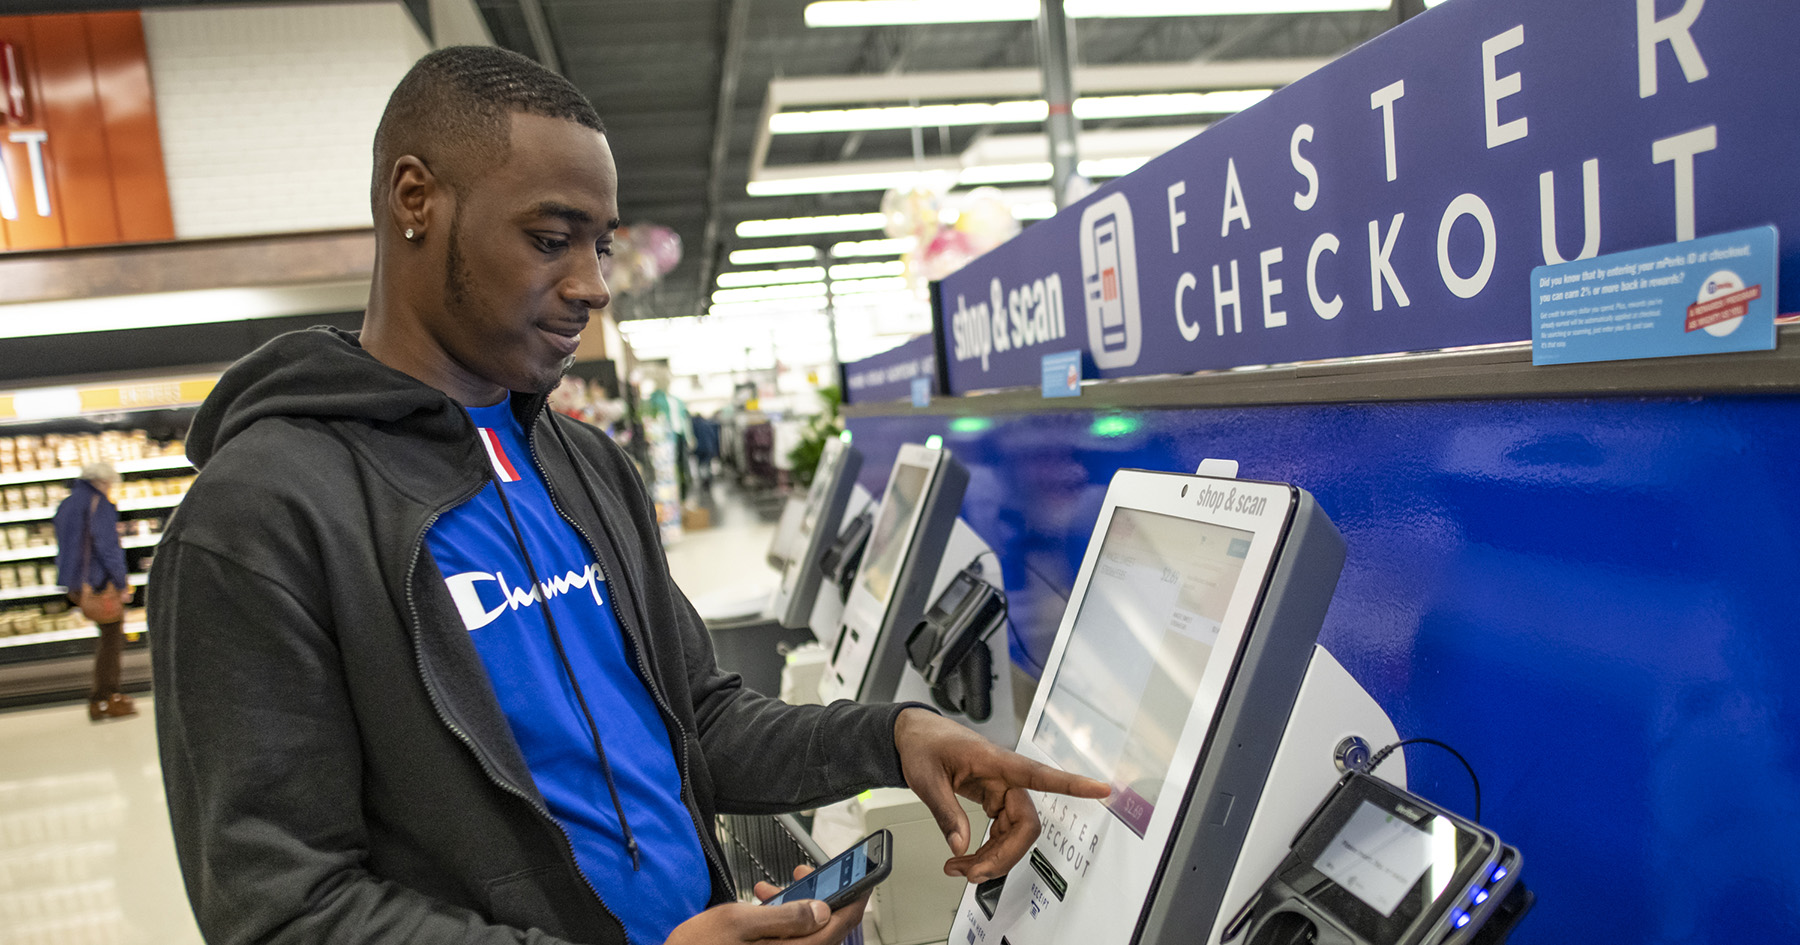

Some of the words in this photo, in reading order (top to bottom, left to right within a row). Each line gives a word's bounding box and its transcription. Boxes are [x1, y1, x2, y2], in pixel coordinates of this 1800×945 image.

[1167, 0, 1710, 254] FASTER
[1174, 125, 1718, 342] CHECKOUT
[1539, 276, 1550, 288] Did
[1551, 277, 1563, 288] you
[1564, 274, 1581, 284] know
[1582, 270, 1597, 281] that
[1597, 268, 1606, 280] by
[1606, 264, 1637, 276] entering
[1638, 262, 1655, 274] your
[1686, 252, 1697, 264] ID
[1698, 251, 1708, 263] at
[1539, 294, 1551, 305] you
[1552, 292, 1563, 301] can
[1564, 290, 1580, 300] earn
[1580, 286, 1592, 297] 2%
[1593, 286, 1600, 296] or
[1601, 284, 1620, 294] more
[1620, 280, 1639, 291] back
[1640, 278, 1648, 289] in
[953, 294, 991, 372] shop
[990, 277, 1010, 353] &
[1009, 272, 1066, 349] scan
[1196, 484, 1224, 515] shop
[1224, 487, 1238, 512] &
[1235, 493, 1268, 517] scan
[1031, 883, 1050, 910] RECEIPT
[966, 909, 977, 927] SCAN
[975, 923, 987, 943] HERE
